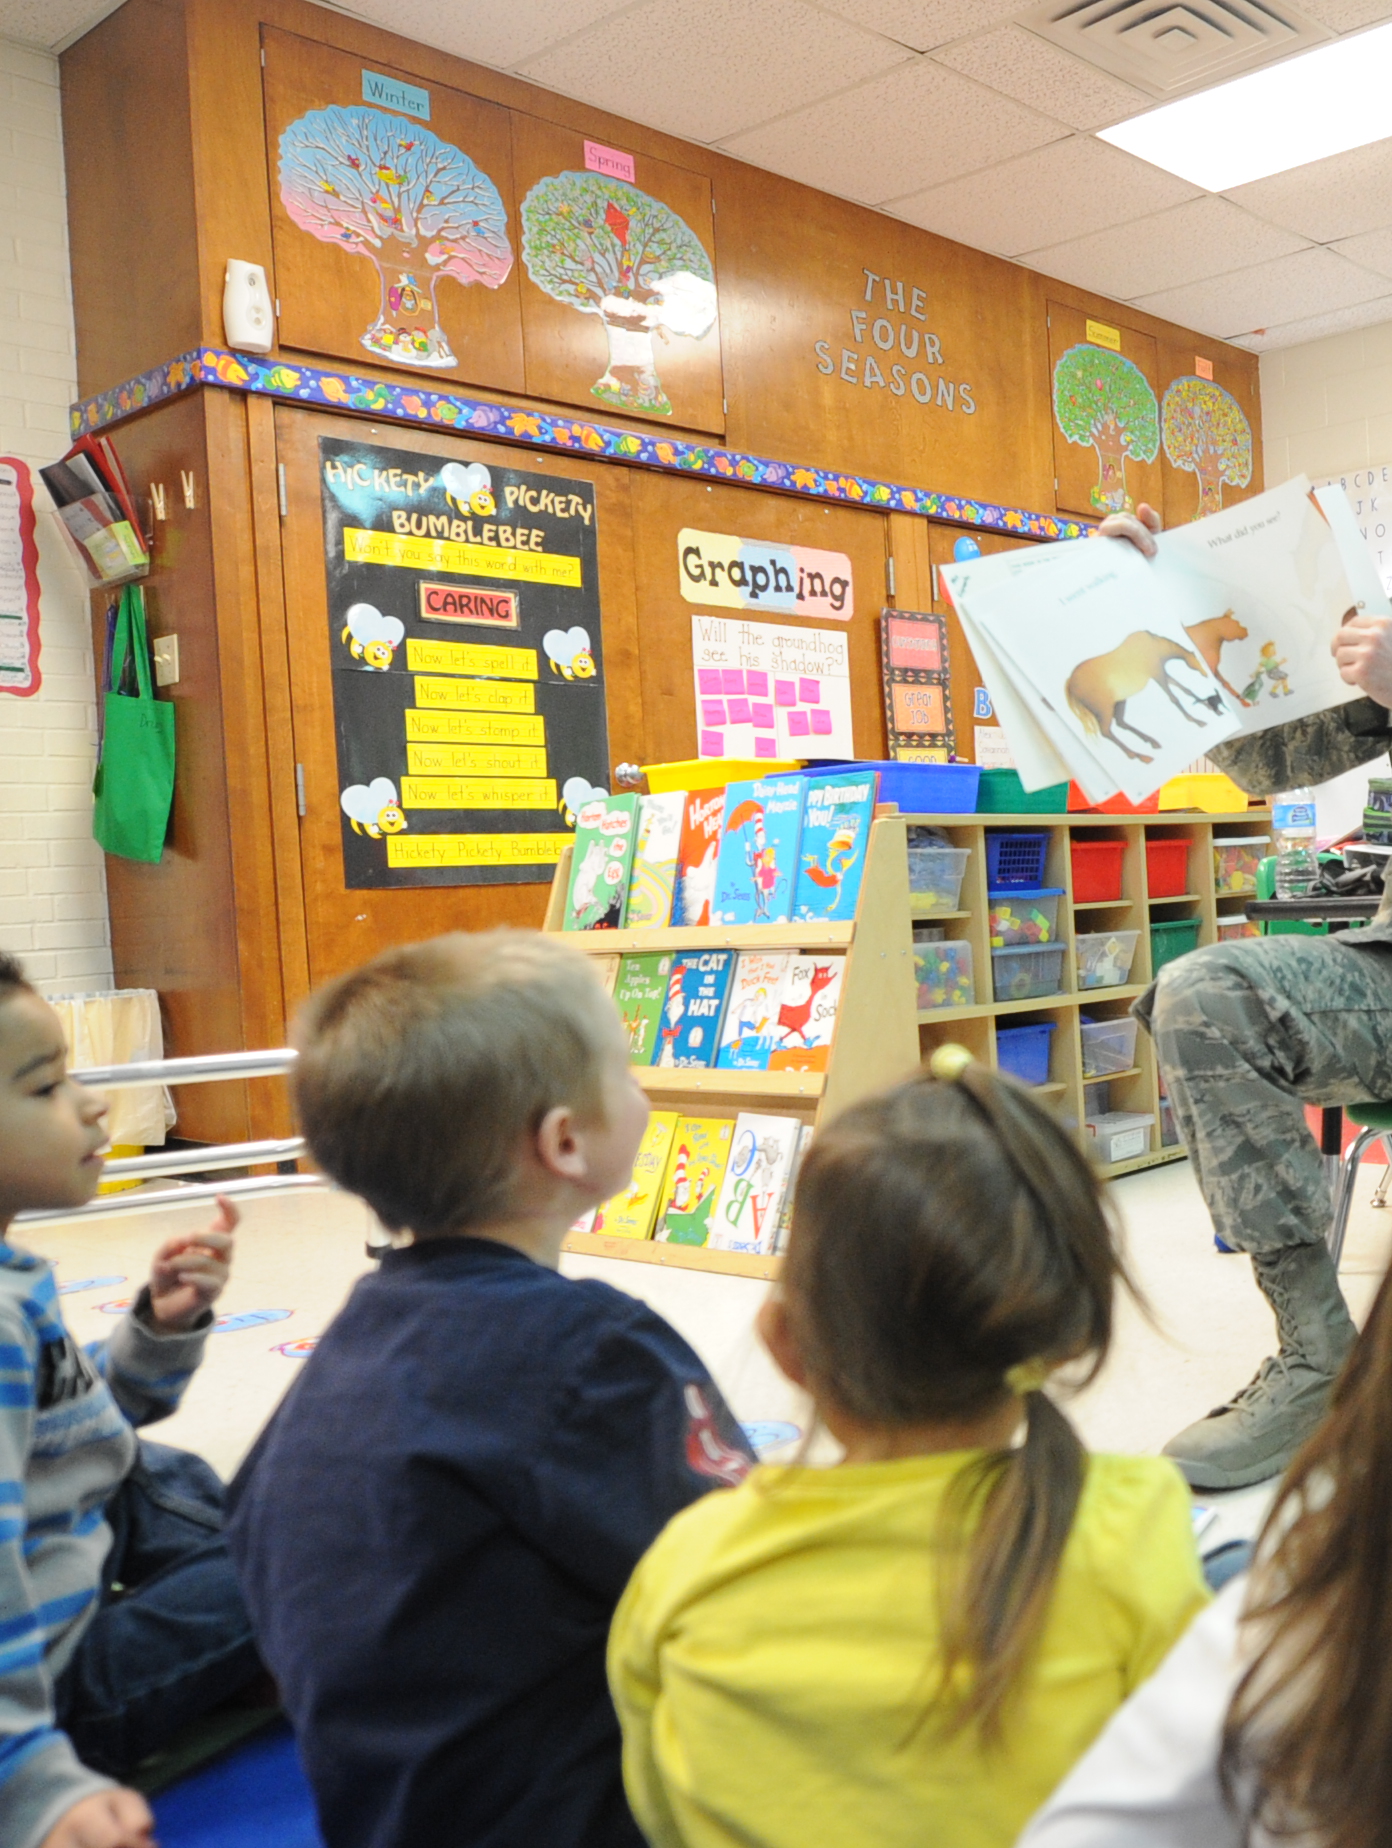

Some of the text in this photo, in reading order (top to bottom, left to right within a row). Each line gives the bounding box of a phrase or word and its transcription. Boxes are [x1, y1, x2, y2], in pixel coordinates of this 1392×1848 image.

[367, 79, 424, 112] Winter
[589, 147, 631, 178] Spring
[862, 267, 927, 321] THE
[851, 309, 944, 364] FOUR
[814, 340, 976, 415] SEASONS
[325, 461, 593, 525] HICKETY PICKETY
[392, 510, 544, 552] BUMBLEBEE
[1207, 533, 1233, 549] What
[349, 535, 574, 579] Won't you say this word with me?
[682, 545, 850, 612] Graphing
[426, 590, 510, 619] CARING
[697, 618, 844, 665] Will the groundhog
[413, 646, 532, 672] Now let's spell it
[701, 646, 835, 675] see his shadow?
[420, 683, 528, 707] Now let's clap it
[411, 717, 537, 739] Now let's stomp it
[413, 751, 539, 769] Now let's shout it
[408, 784, 549, 806] Now let's whisper it
[394, 842, 502, 863] Hickety Pickety
[698, 953, 728, 973] CAT
[791, 965, 811, 986] Fox
[687, 998, 720, 1017] HAT
